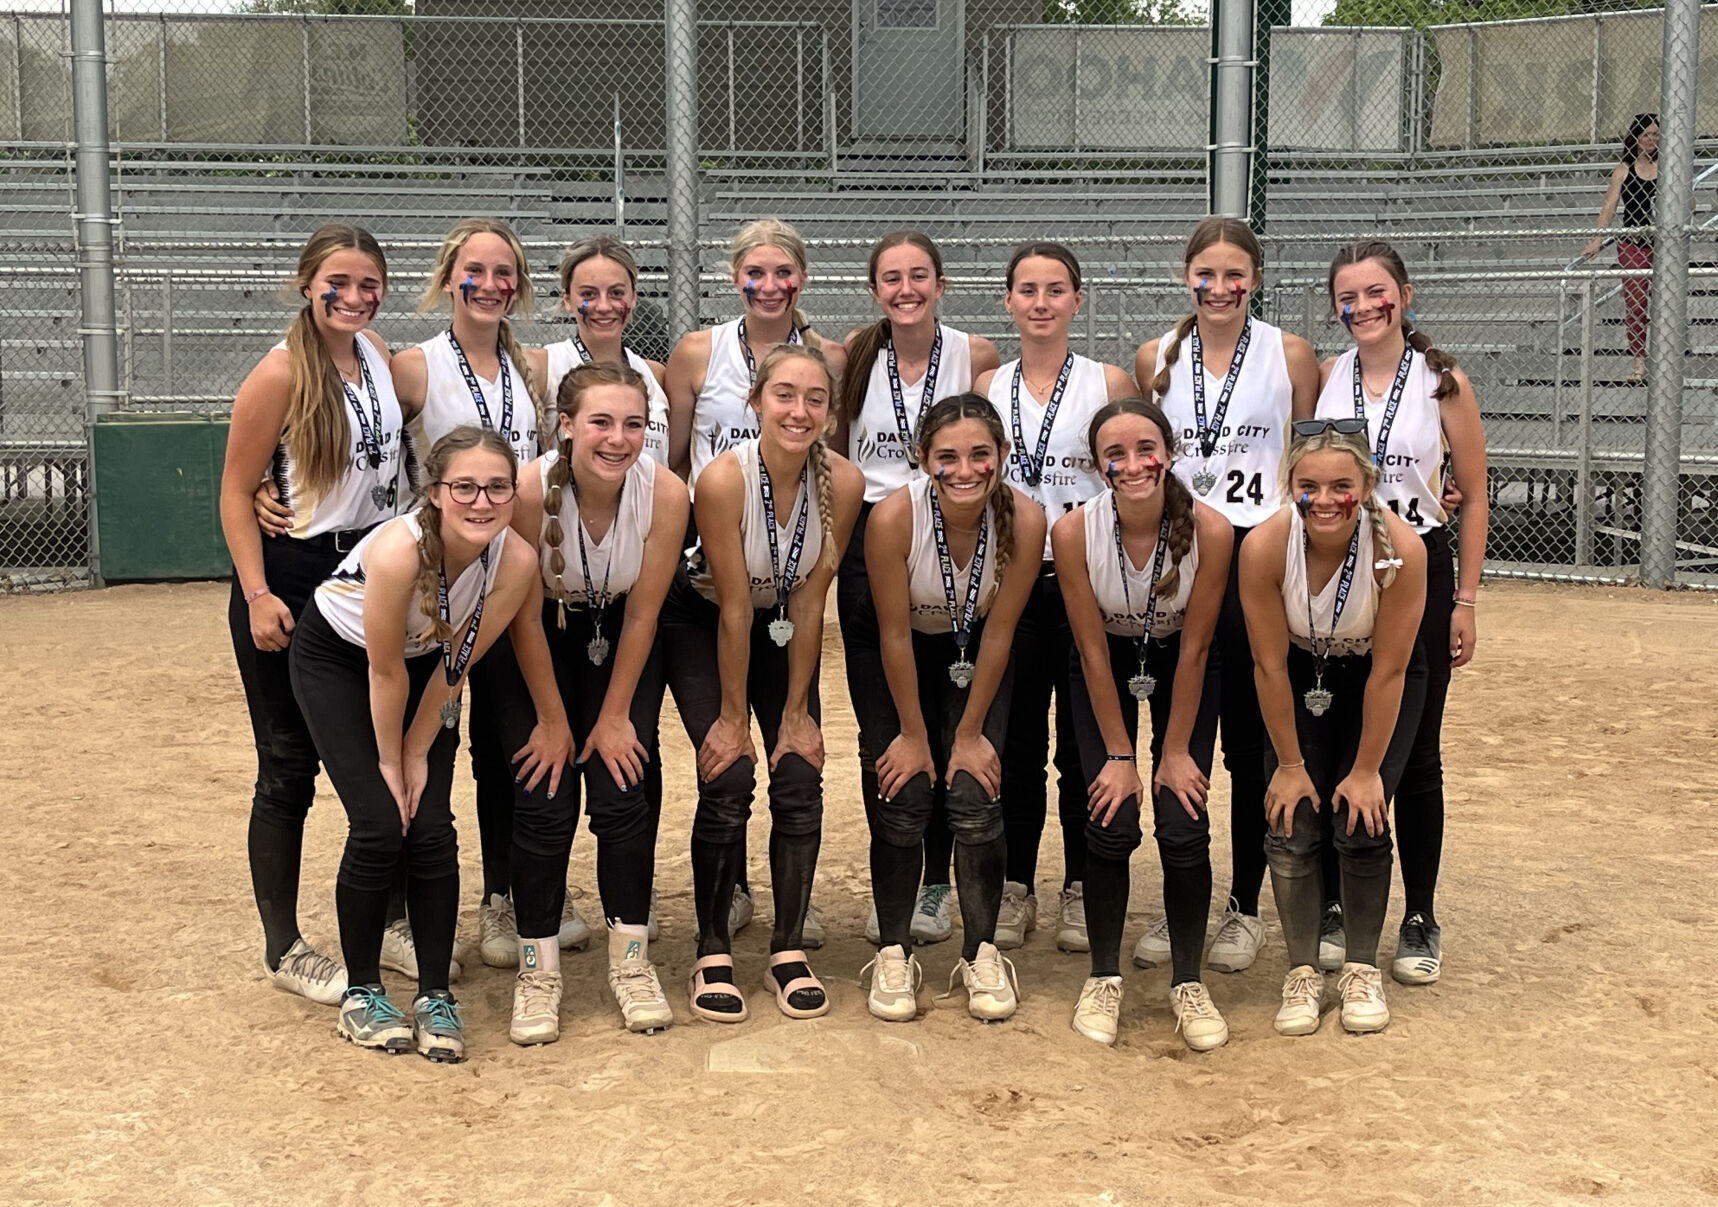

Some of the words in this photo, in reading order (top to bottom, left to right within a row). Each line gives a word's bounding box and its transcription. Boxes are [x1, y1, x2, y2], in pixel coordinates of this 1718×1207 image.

[1397, 359, 1409, 379] PLACE
[1194, 375, 1202, 392] PLACE
[1223, 373, 1236, 392] PLACE
[1045, 402, 1057, 420] PLACE
[1385, 400, 1397, 419] PLACE
[1210, 412, 1222, 432] PLACE
[1237, 425, 1270, 439] CITY
[1226, 469, 1264, 506] 24
[766, 511, 775, 529] PLACE
[933, 508, 943, 529] PLACE
[785, 558, 797, 579] PLACE
[939, 554, 950, 574] PLACE
[971, 555, 983, 576] PLACE
[1335, 579, 1350, 600] PLACE
[963, 600, 974, 621] PLACE
[457, 643, 471, 664] PLACE
